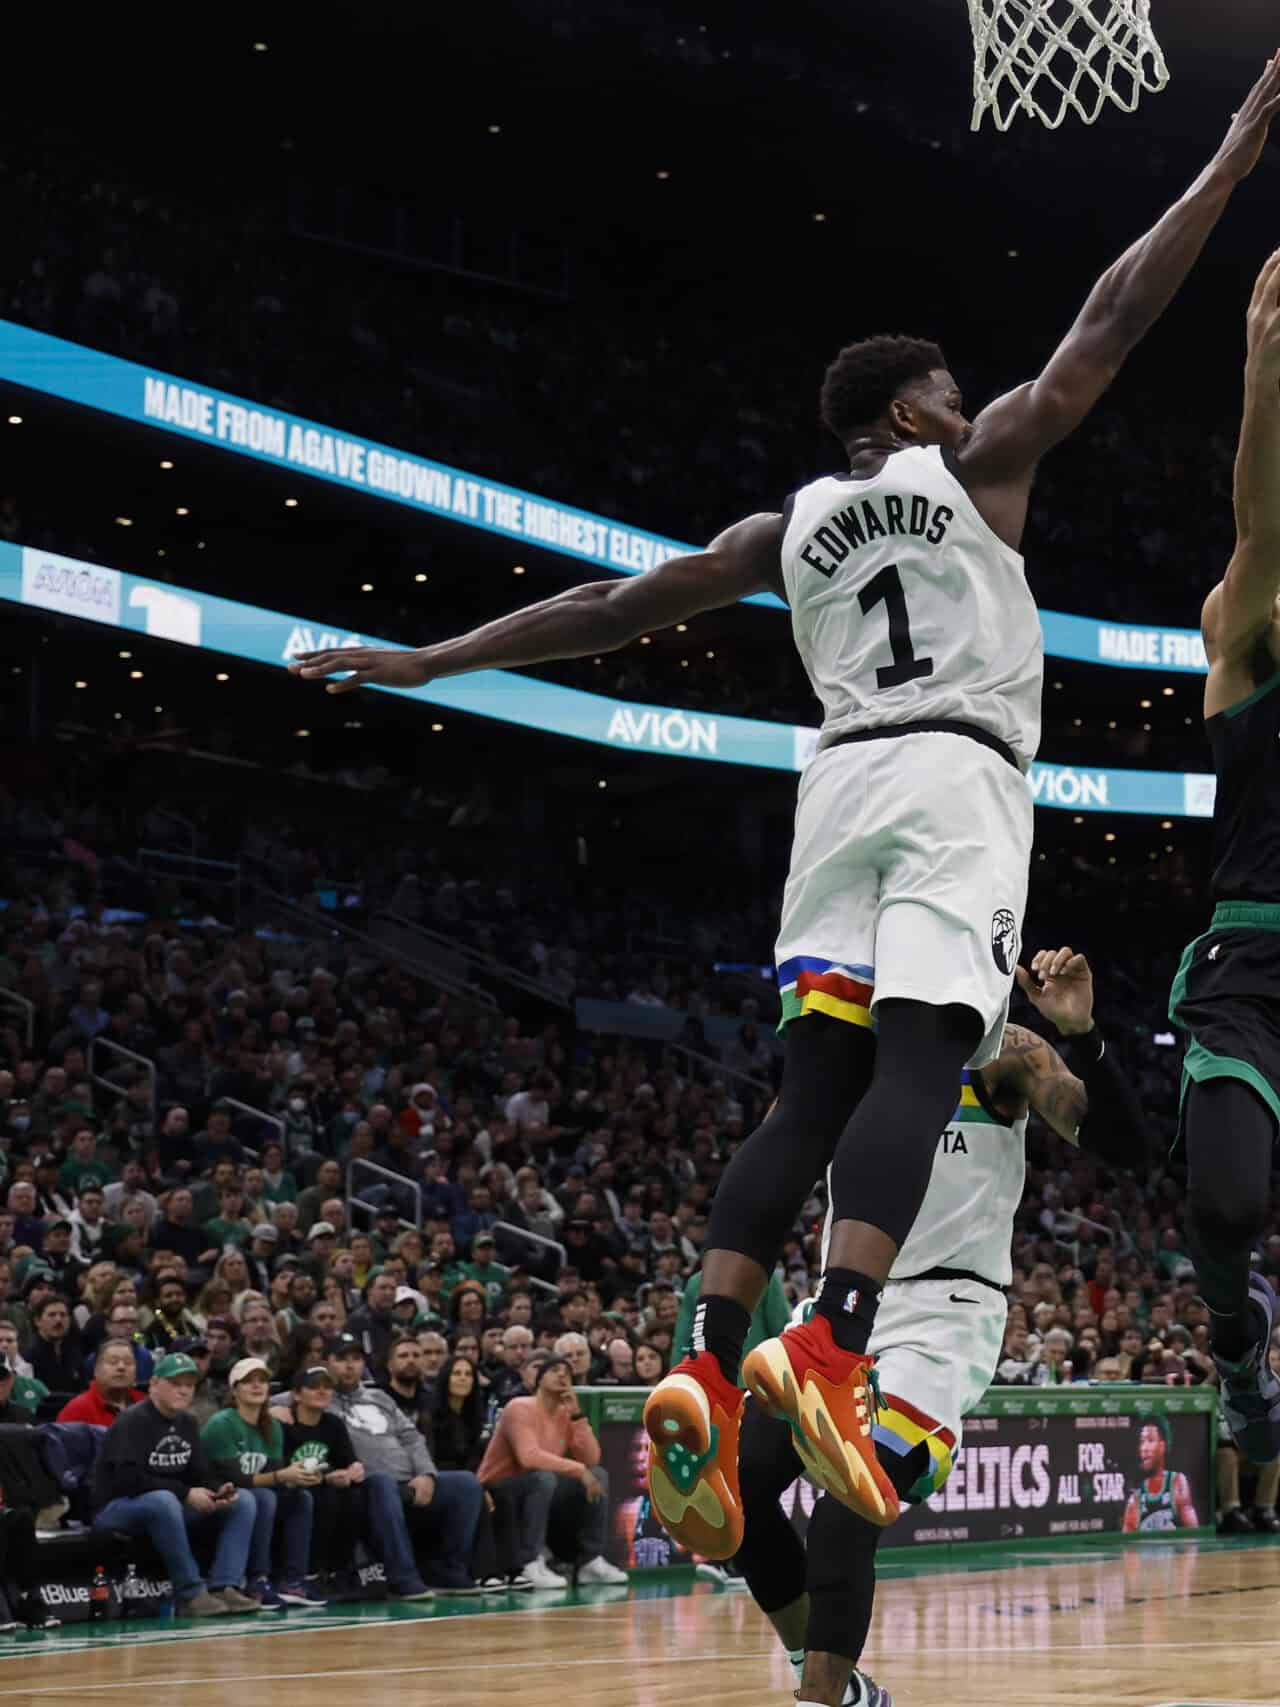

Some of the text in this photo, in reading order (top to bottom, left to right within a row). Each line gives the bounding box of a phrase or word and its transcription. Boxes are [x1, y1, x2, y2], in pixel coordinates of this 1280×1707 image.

[144, 376, 214, 435] MADE
[216, 400, 286, 458] FROM
[287, 424, 365, 483] AGAVE
[367, 449, 451, 510] GROWN
[452, 478, 480, 519] AT
[481, 486, 522, 533] THE
[523, 499, 609, 559] HIGHEST
[800, 495, 954, 579] EDWARDS
[857, 564, 934, 690] 1
[1098, 627, 1208, 668] MADE FRO
[606, 707, 718, 755] AVIÓN
[1024, 766, 1109, 806] VIÓN
[1077, 1443, 1106, 1473] FOR
[1057, 1473, 1126, 1504] ALL STAR
